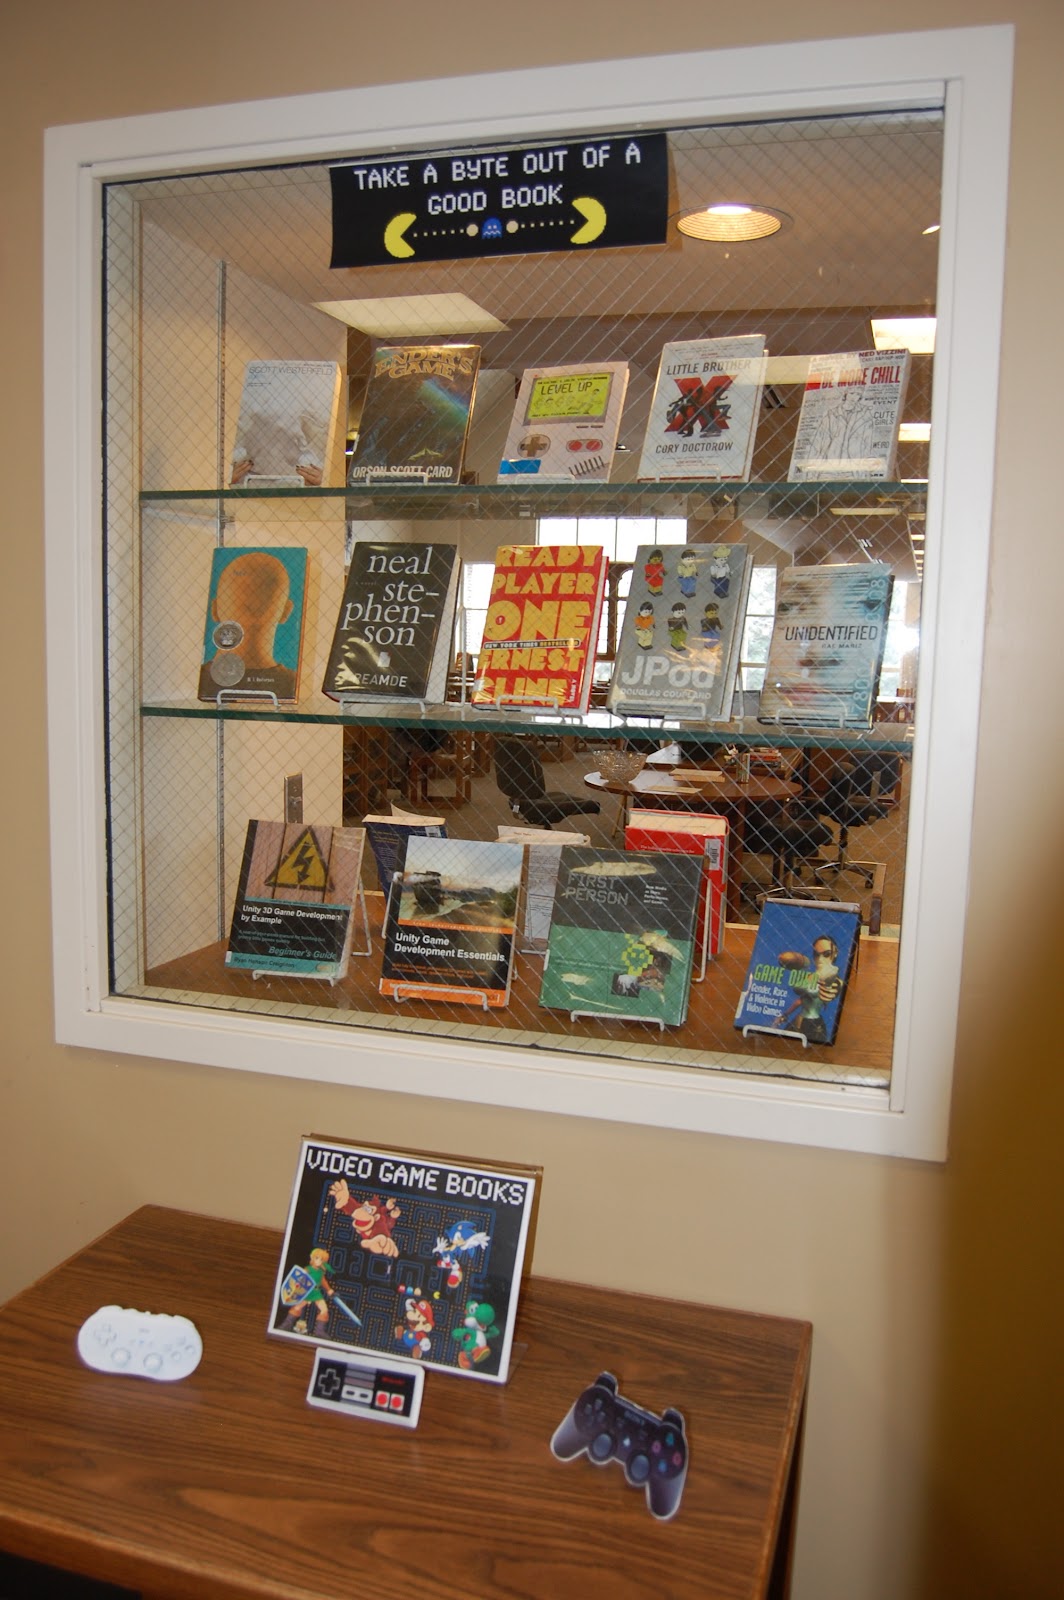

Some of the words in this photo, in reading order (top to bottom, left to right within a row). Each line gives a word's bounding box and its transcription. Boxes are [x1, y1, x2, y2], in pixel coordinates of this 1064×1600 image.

[354, 166, 410, 190] TAKE
[423, 163, 438, 184] A
[452, 157, 509, 181] BYTE
[523, 150, 567, 174] OUT
[582, 145, 611, 168] OF
[625, 142, 641, 164] A
[428, 191, 487, 215] GOOD
[501, 184, 563, 209] BOOK
[375, 349, 473, 378] ENDER'S
[389, 361, 456, 381] GAME
[666, 363, 699, 375] LITTLE
[702, 360, 751, 373] BROTHER
[871, 365, 901, 384] CHILL
[541, 383, 573, 395] LEVEL
[578, 381, 592, 392] UP
[873, 410, 895, 419] CUTE
[655, 443, 680, 454] CORY
[682, 441, 733, 452] DOCTOROW
[426, 466, 453, 478] CARD
[366, 546, 433, 575] neal
[495, 546, 602, 567] READY
[383, 580, 440, 603] ste-
[490, 572, 595, 594] PLAYER
[340, 593, 435, 631] phen-
[484, 599, 591, 642] ONE
[364, 625, 415, 647] son
[477, 648, 585, 672] ERNEST
[355, 673, 408, 688] REAMDE
[621, 655, 717, 688] JPod
[475, 676, 568, 706] CLINE
[620, 688, 661, 697] DOUGLAS
[568, 872, 617, 889] FIRST
[565, 887, 629, 906] PERSON
[241, 914, 250, 923] by
[251, 915, 282, 925] Example
[242, 904, 261, 914] Unity
[262, 906, 273, 914] 3D
[274, 908, 295, 917] Game
[296, 910, 343, 921] Development
[396, 932, 420, 944] Unity
[422, 935, 450, 946] Game
[269, 946, 311, 957] Beginner's
[313, 950, 337, 959] Guide
[394, 943, 456, 957] Development
[457, 949, 505, 962] Essentials
[754, 964, 785, 985] GAME
[788, 968, 819, 991] OVER
[751, 983, 772, 995] Gender,
[773, 986, 788, 997] Race
[747, 1002, 762, 1013] Video
[762, 1006, 783, 1017] Games
[754, 994, 778, 1006] Violence
[779, 997, 786, 1007] in
[306, 1148, 372, 1179] VIDEO
[379, 1161, 440, 1191] GAME
[445, 1173, 525, 1206] BOOKS
